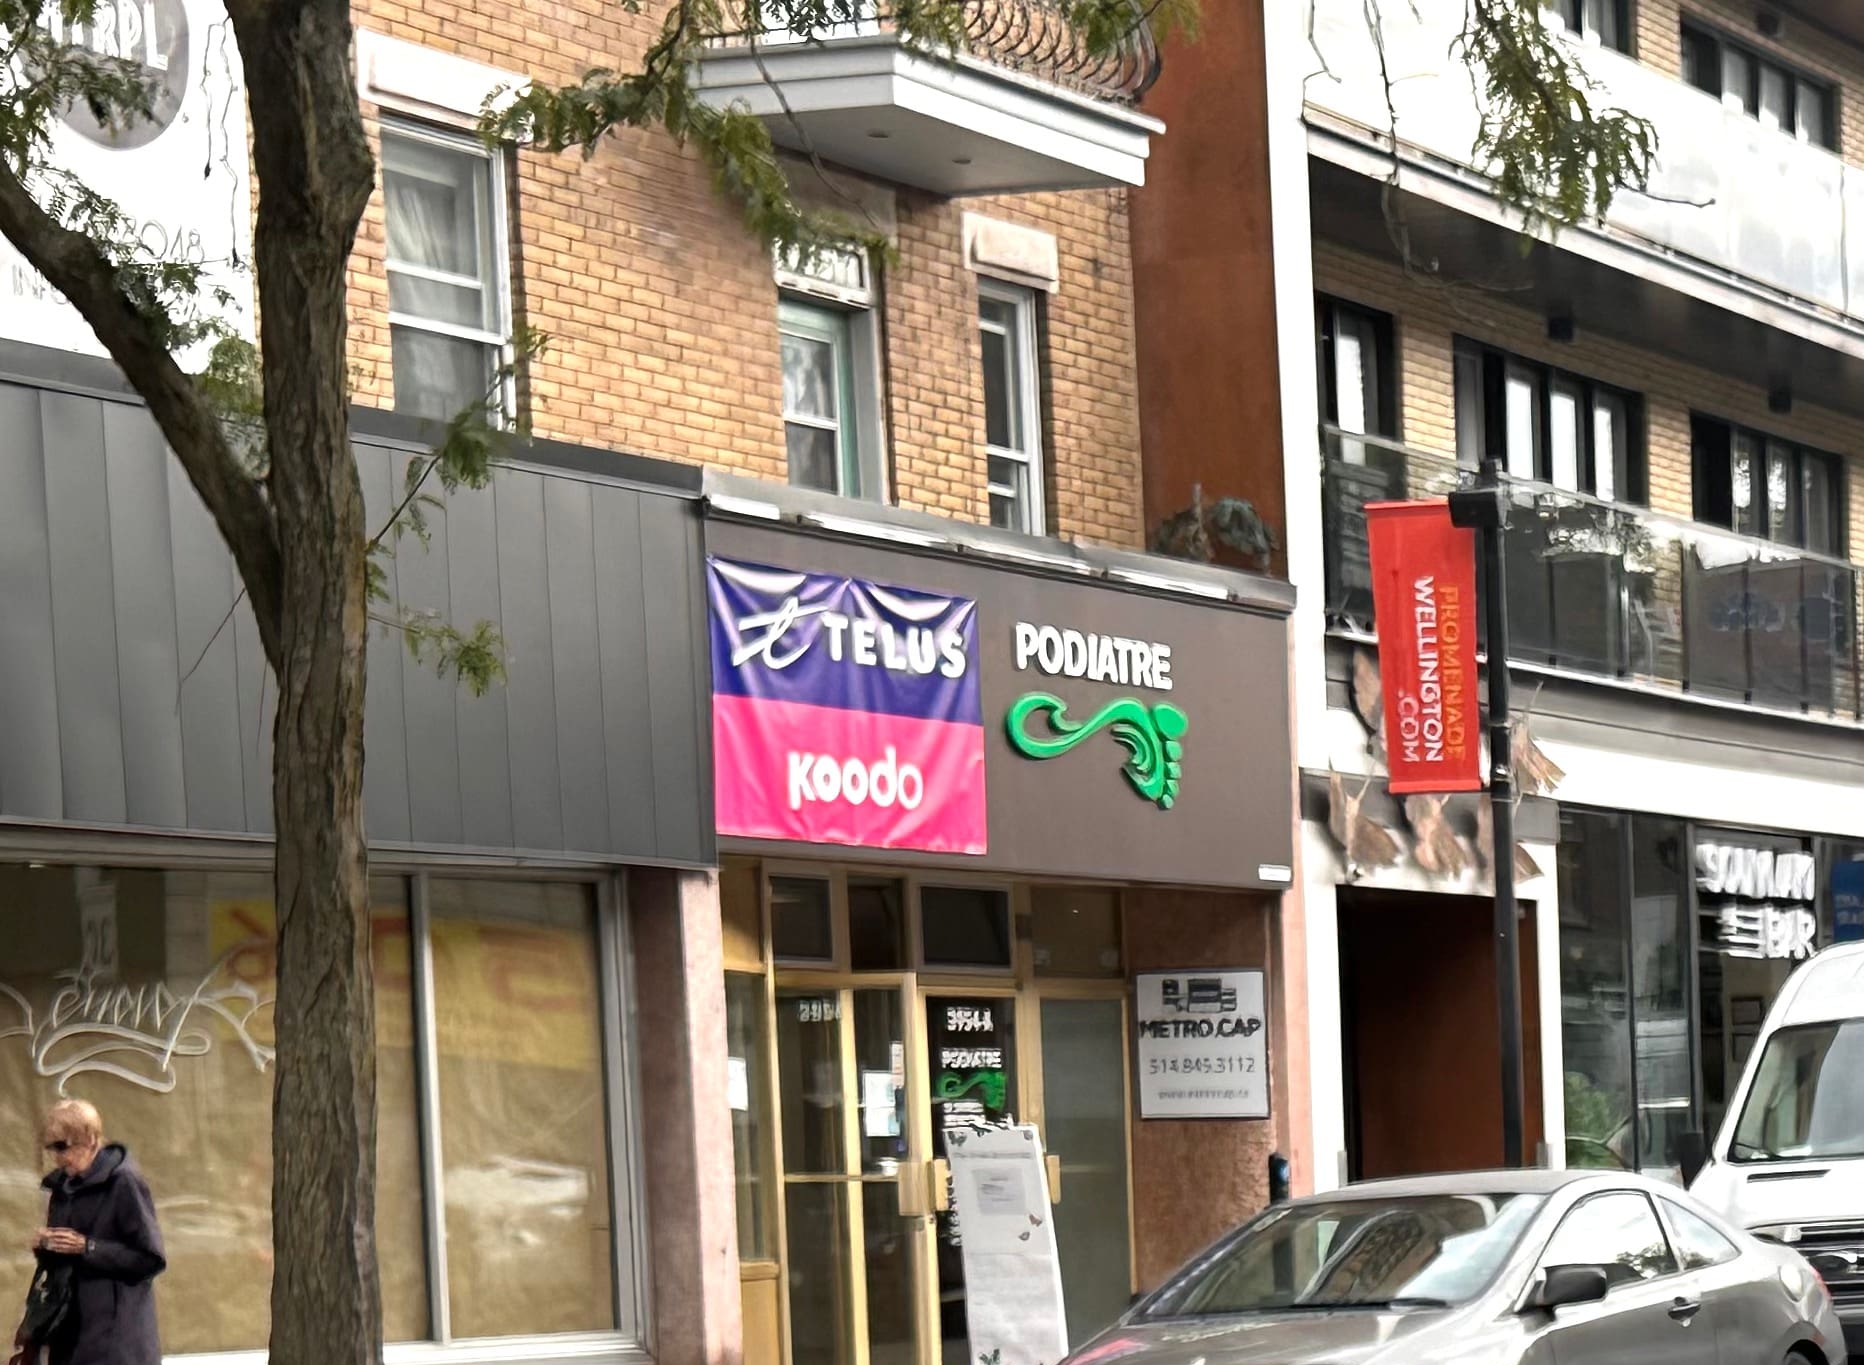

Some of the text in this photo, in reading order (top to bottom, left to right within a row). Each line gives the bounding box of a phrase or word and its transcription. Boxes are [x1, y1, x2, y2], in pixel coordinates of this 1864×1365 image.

[822, 612, 967, 679] TELUS
[1015, 622, 1173, 691] PODIATRE
[1414, 575, 1444, 762] WELLINGTON
[1439, 585, 1466, 760] PROMENADE
[1398, 689, 1421, 762] .COM
